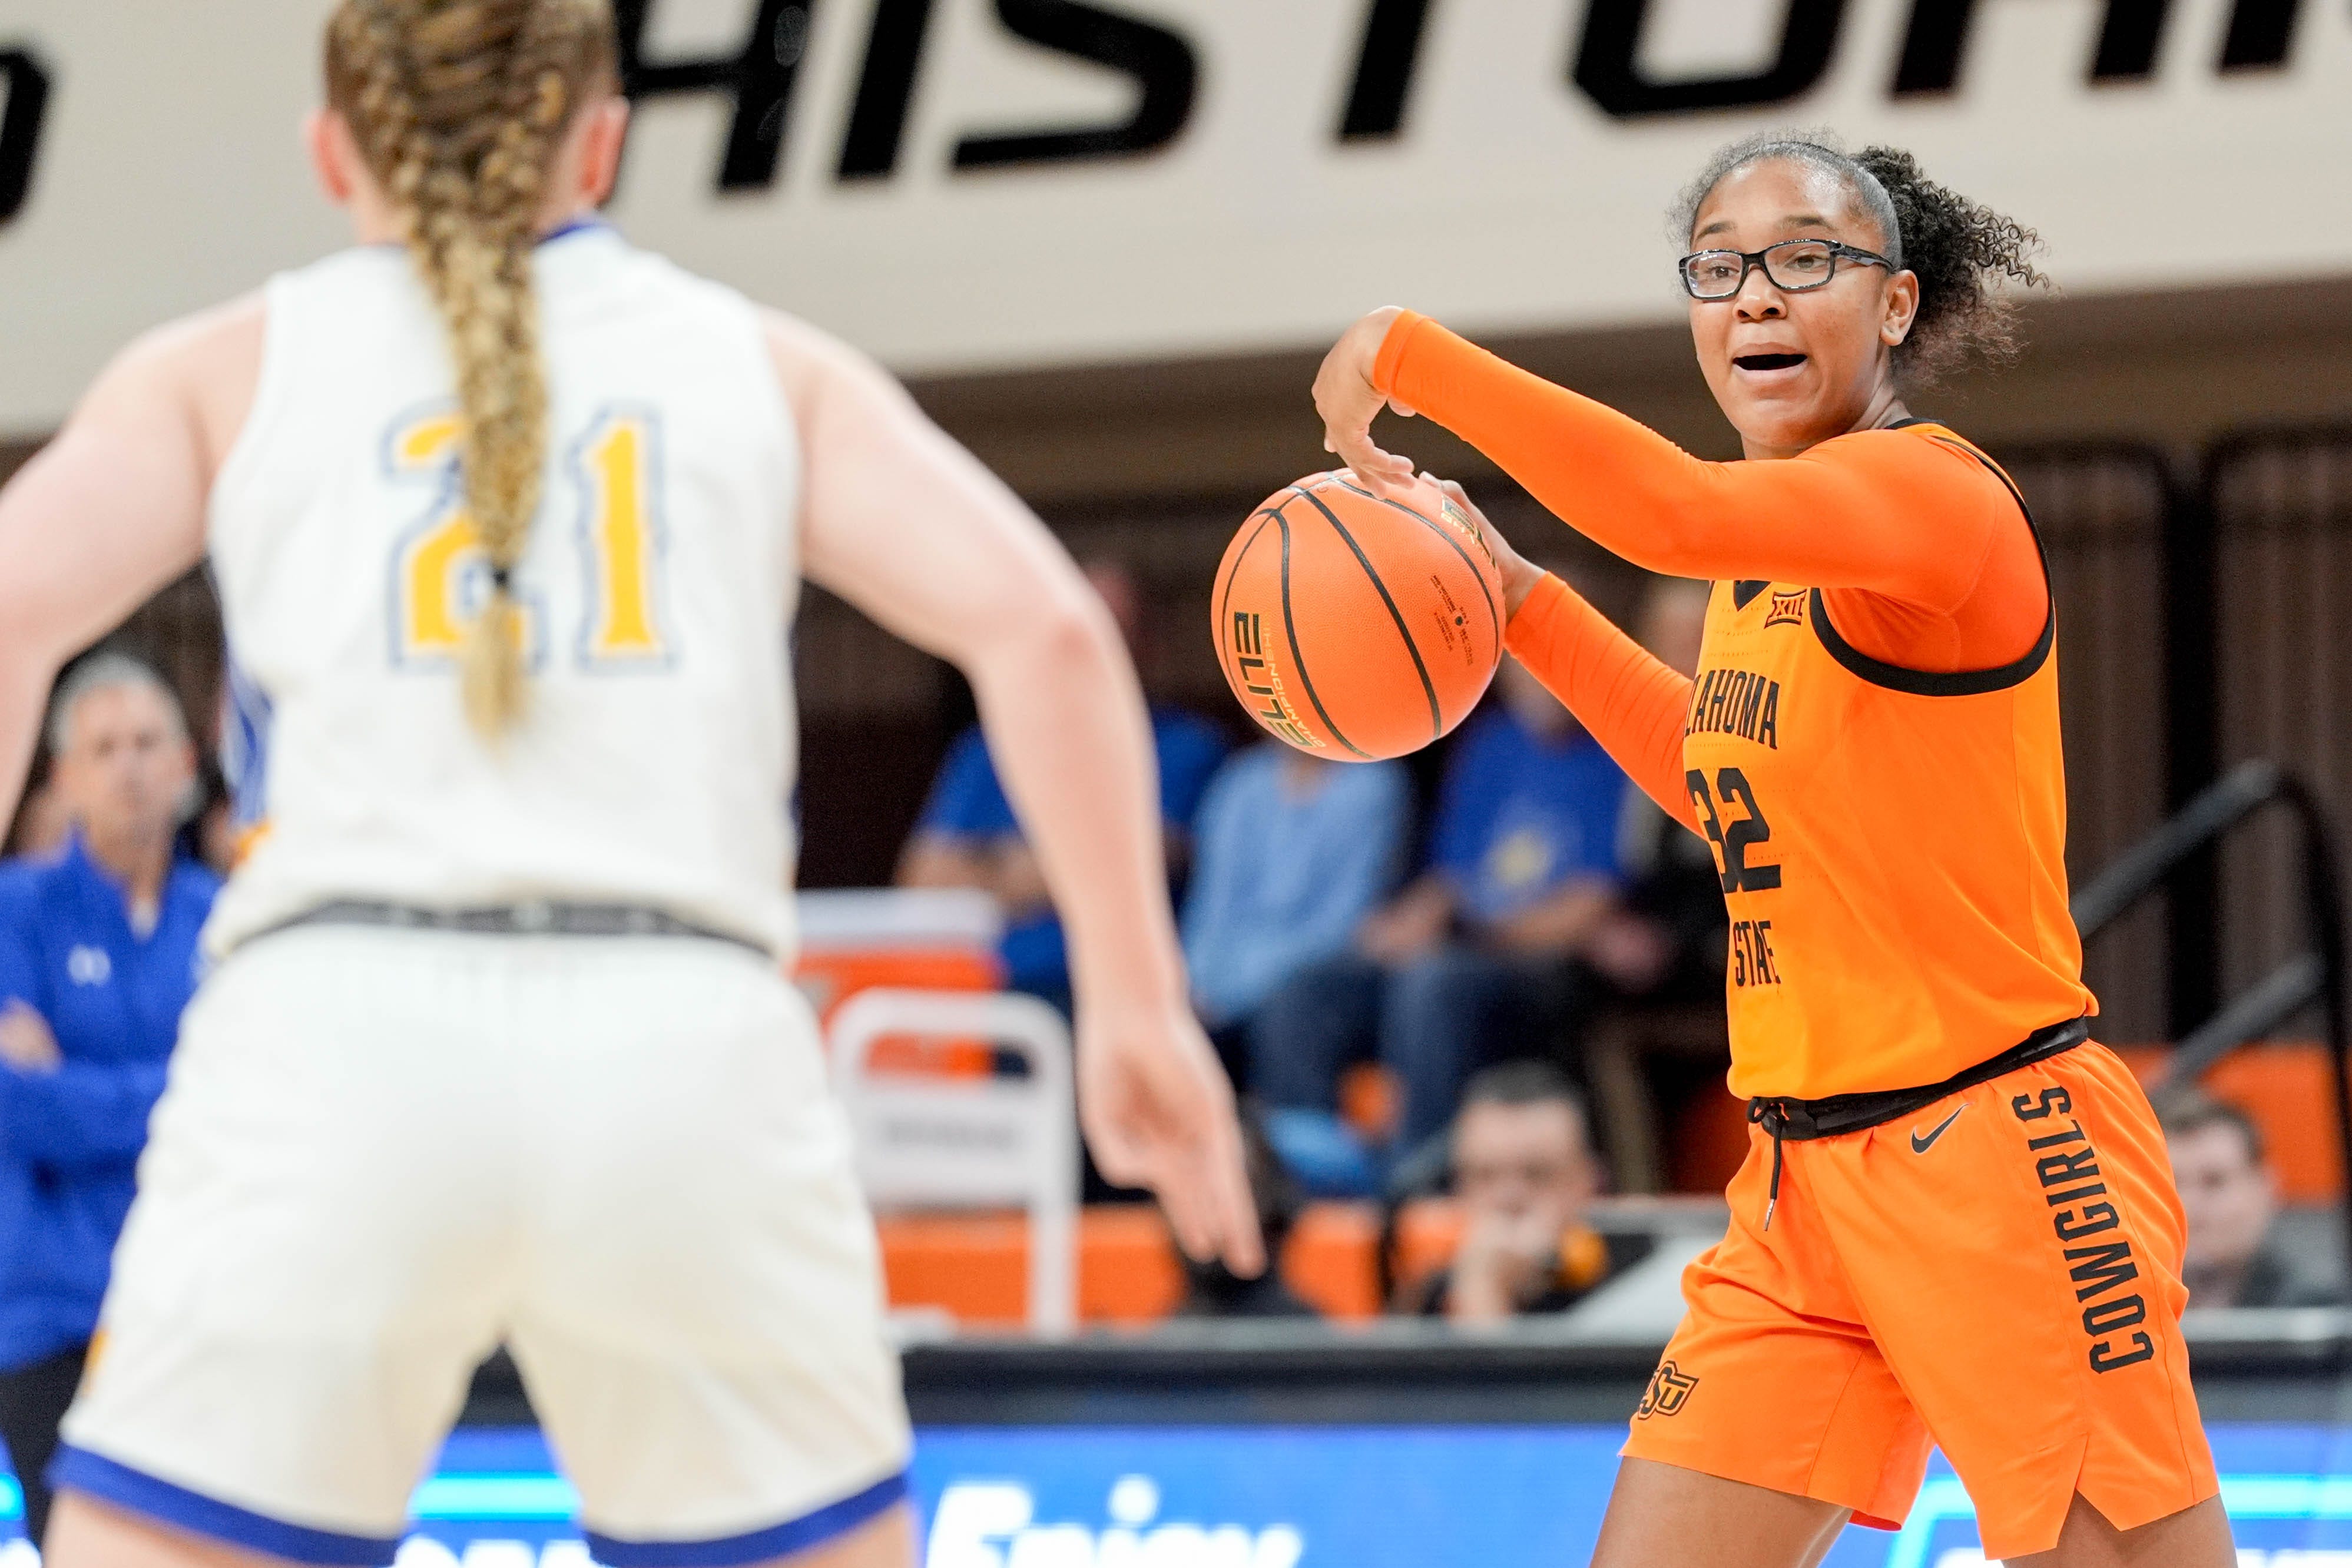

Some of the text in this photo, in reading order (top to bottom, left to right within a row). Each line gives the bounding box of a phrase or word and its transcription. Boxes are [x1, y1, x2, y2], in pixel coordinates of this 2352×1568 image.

[382, 399, 684, 675] 21
[1764, 589, 1807, 629] XII
[1234, 611, 1314, 747] ELITE
[1685, 669, 1779, 750] LAHOMA
[1686, 768, 1781, 894] 32
[2012, 1085, 2154, 1374] COWGIRLS
